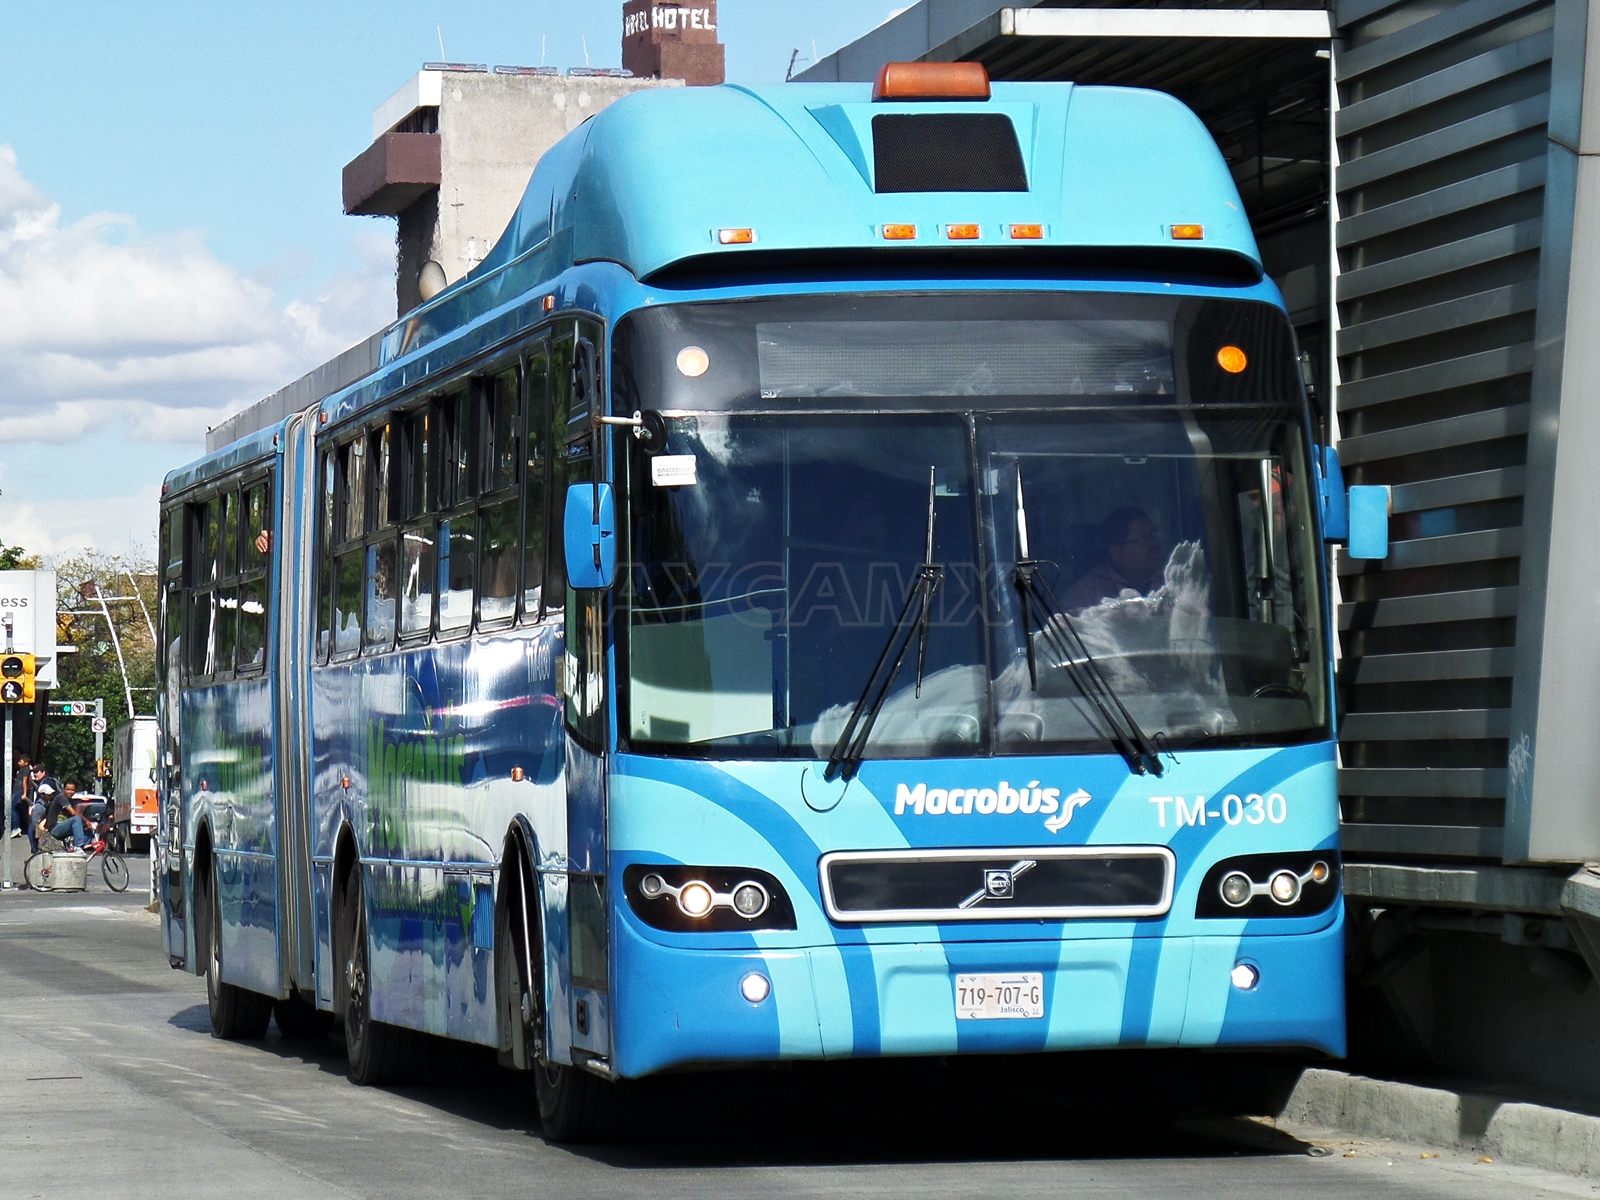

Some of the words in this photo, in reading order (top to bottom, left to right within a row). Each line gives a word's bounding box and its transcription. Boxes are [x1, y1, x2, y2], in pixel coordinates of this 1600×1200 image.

[651, 6, 716, 30] HOTEL
[0, 597, 28, 608] ess
[894, 780, 1061, 815] Macrobús
[1149, 792, 1287, 828] TM-030
[959, 986, 1039, 1006] 719-707-G
[1000, 1006, 1025, 1014] Jalisco
